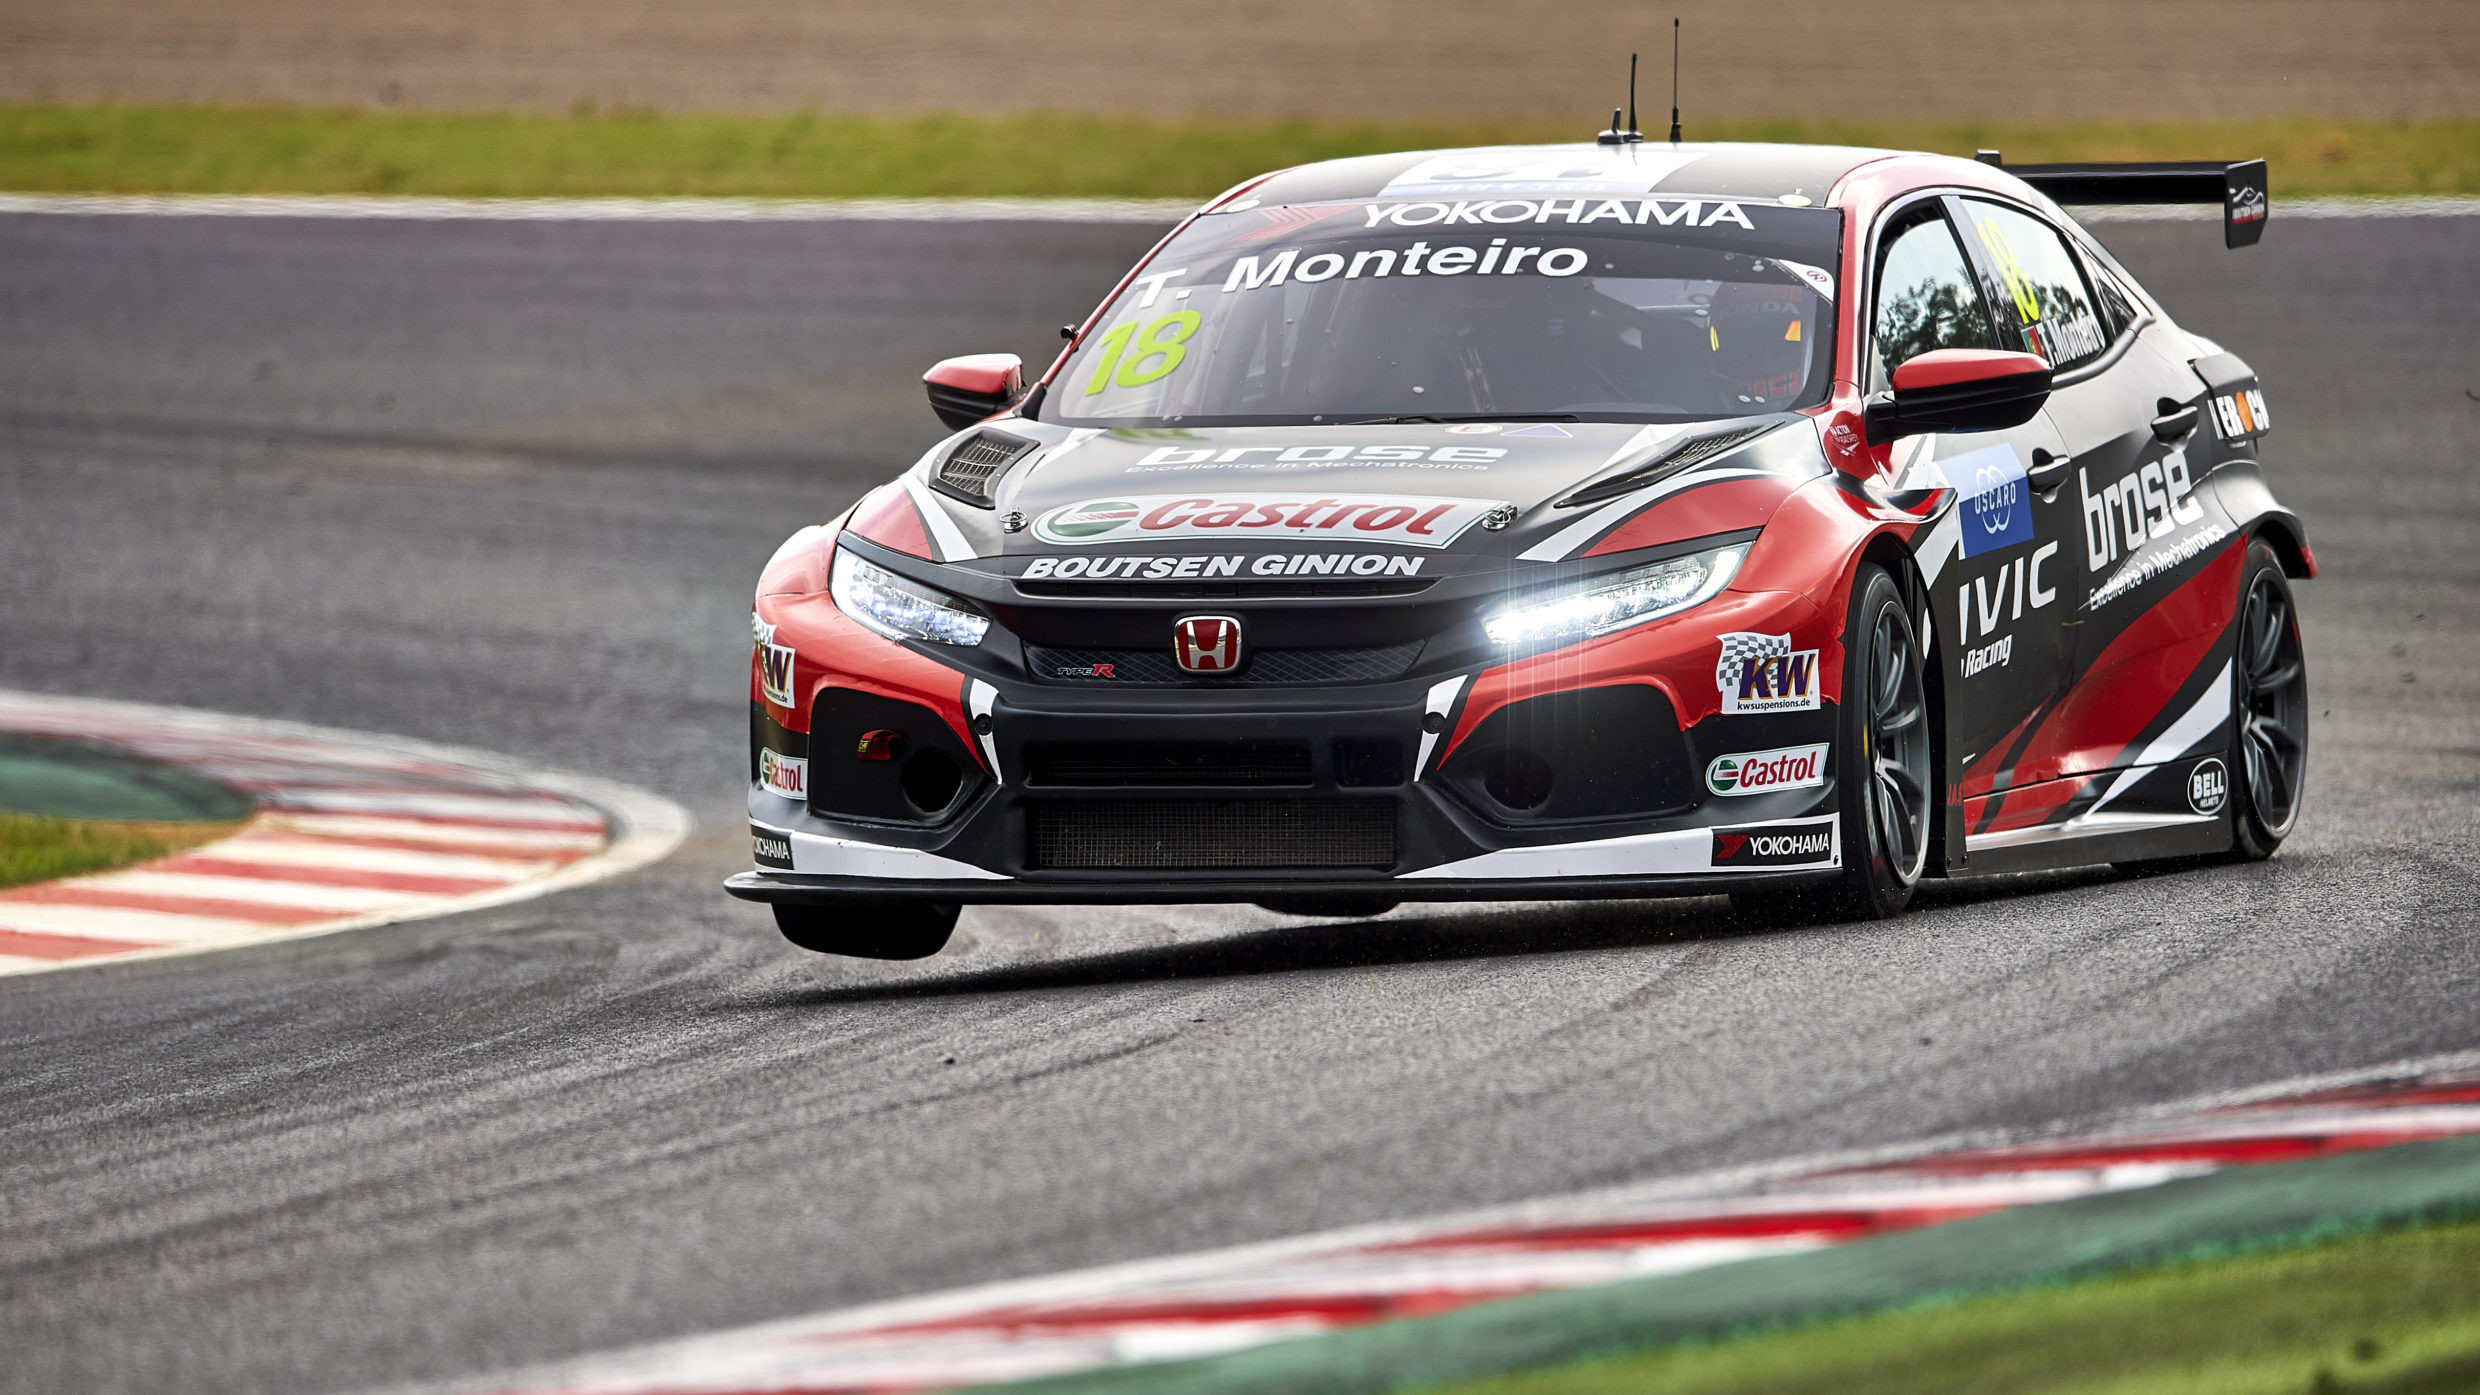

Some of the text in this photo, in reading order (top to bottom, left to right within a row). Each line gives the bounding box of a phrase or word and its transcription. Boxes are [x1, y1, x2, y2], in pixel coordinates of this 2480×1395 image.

[1363, 199, 1756, 230] YOKOHAMA
[1135, 238, 1589, 309] T. Monteiro
[1976, 216, 2040, 325] 18
[1712, 301, 1800, 316] ONDA
[1084, 310, 1202, 397] 18
[1125, 462, 1266, 473] Excellence
[1307, 460, 1489, 471] Mechatronics
[1136, 446, 1508, 466] brose
[1974, 482, 2016, 514] OSCARO
[2079, 450, 2204, 572] brose
[1138, 498, 1458, 536] Castrol
[1020, 555, 1426, 580] BOUTSEN GINION
[2089, 523, 2226, 611] Excellence in Mechatronics
[1959, 540, 2058, 646] IVIC
[1965, 634, 2013, 678] Racing
[1738, 653, 1816, 700] KW
[1737, 698, 1811, 711] kwsuspensions.de
[1741, 751, 1816, 788] Castrol
[2193, 770, 2224, 800] BELL
[1750, 832, 1829, 856] YOKOHAMA
